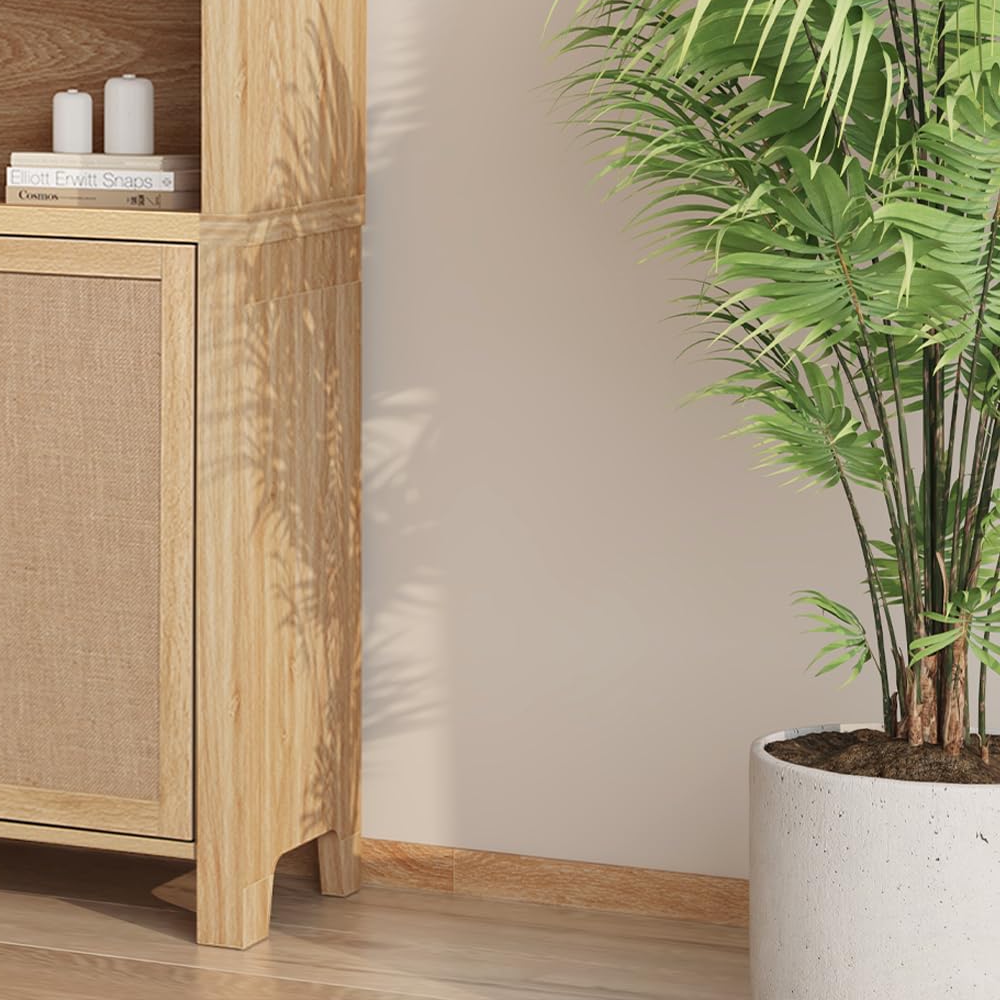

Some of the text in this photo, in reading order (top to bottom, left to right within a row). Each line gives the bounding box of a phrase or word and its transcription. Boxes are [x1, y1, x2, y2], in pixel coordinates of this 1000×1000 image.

[10, 169, 153, 189] Elliott Erwitt Snaps
